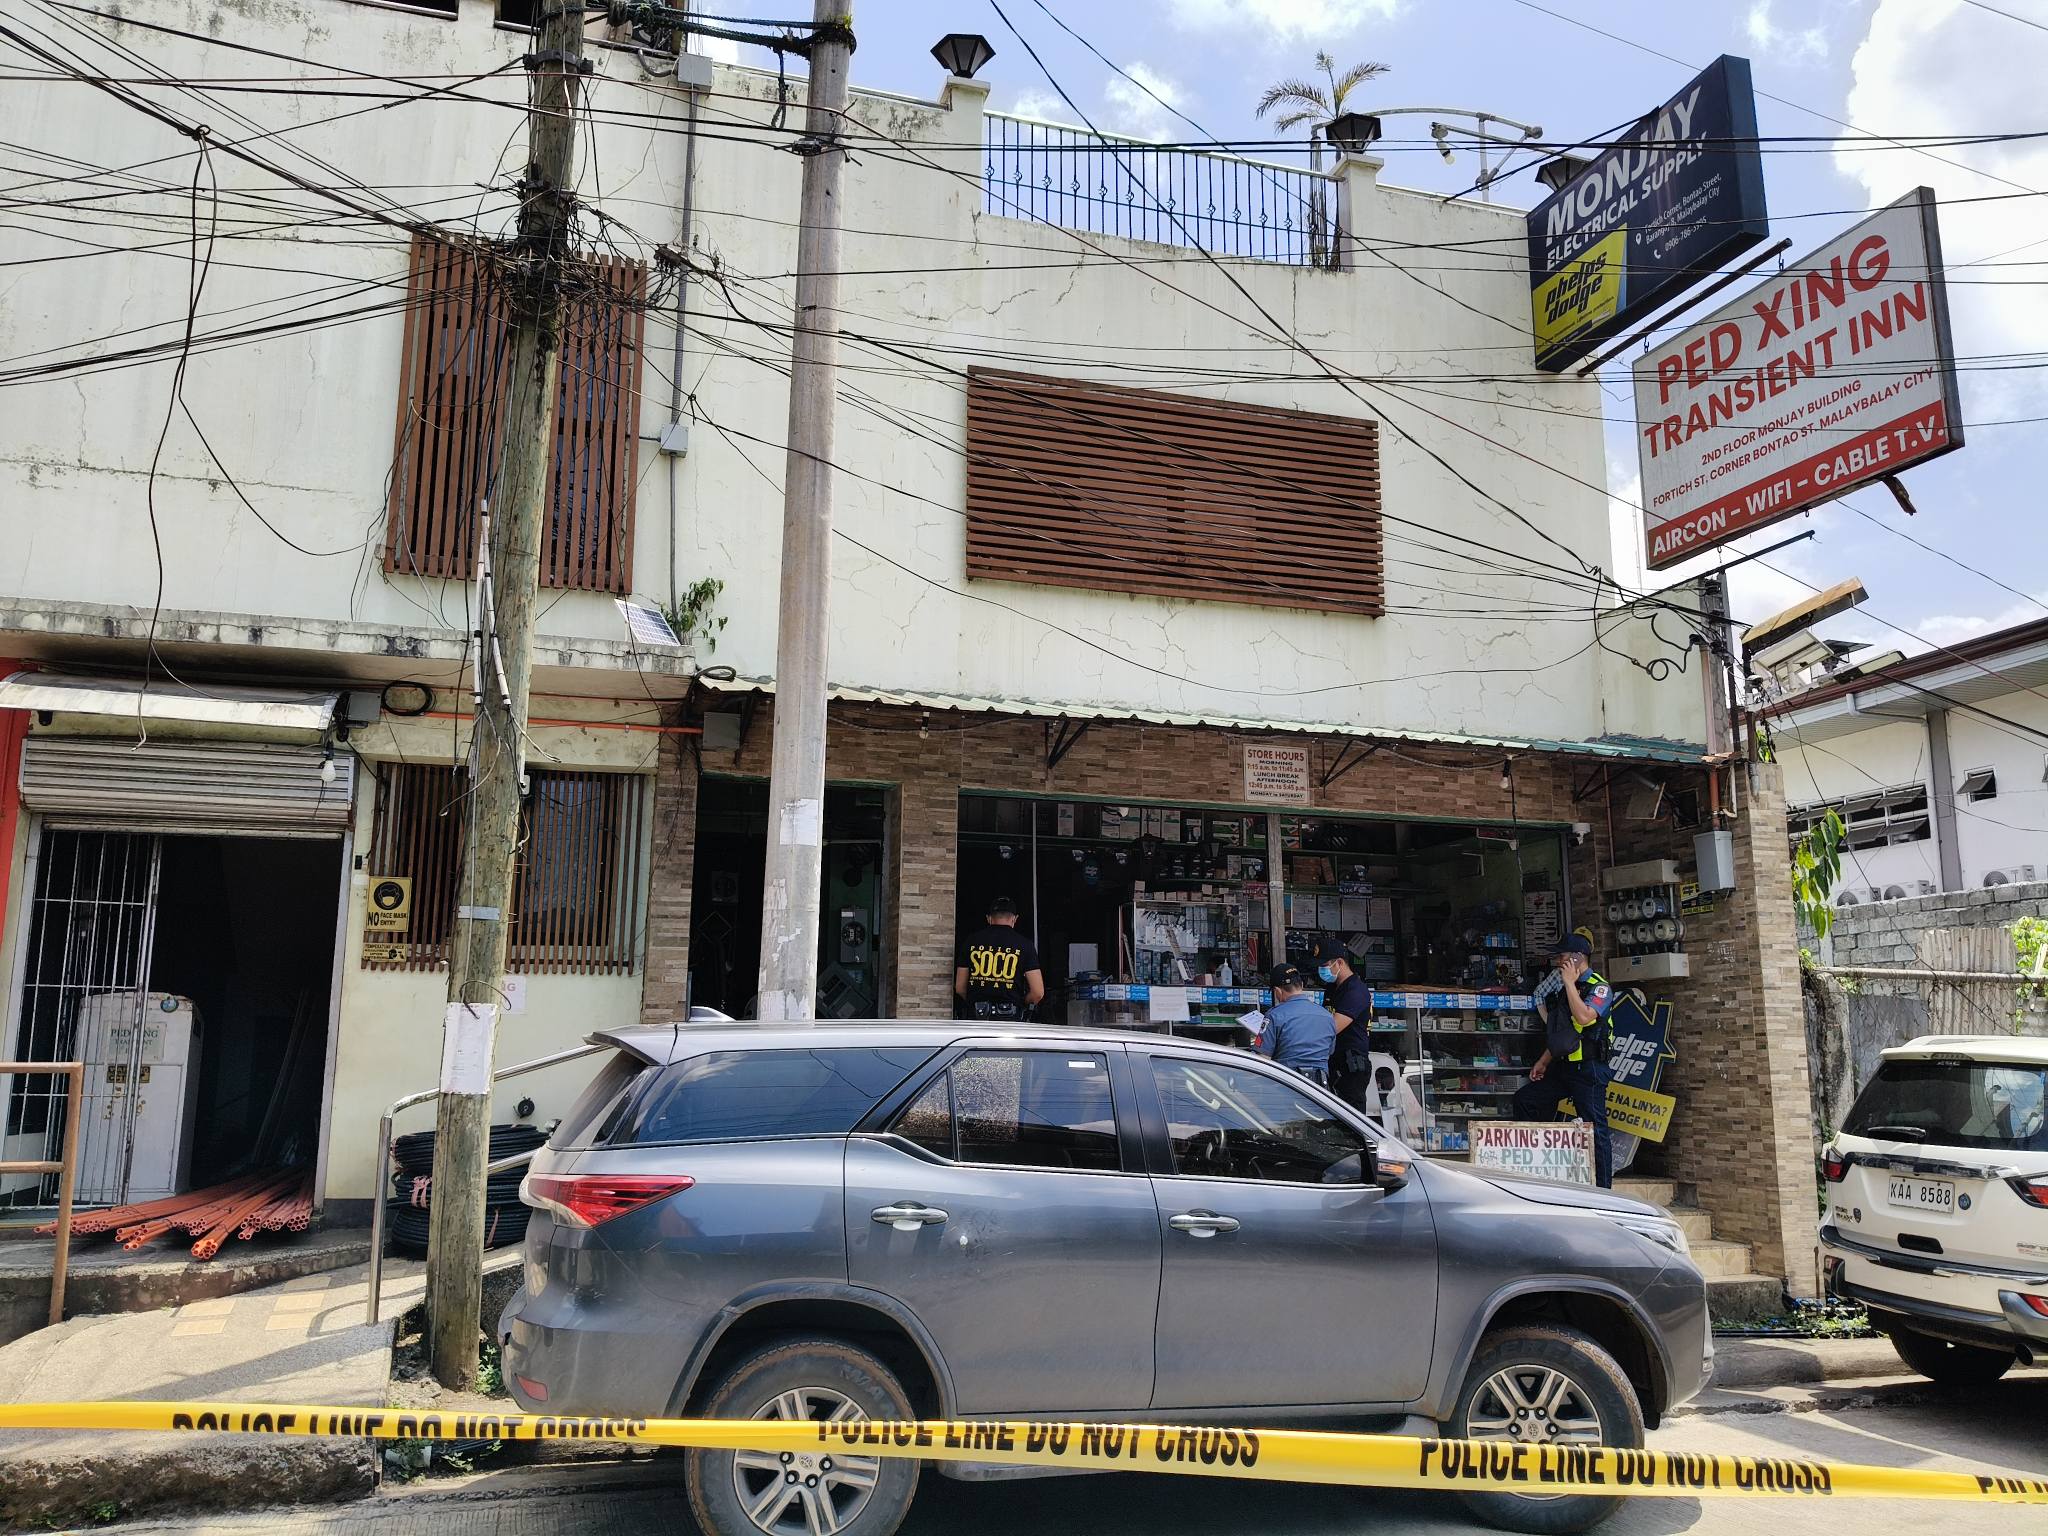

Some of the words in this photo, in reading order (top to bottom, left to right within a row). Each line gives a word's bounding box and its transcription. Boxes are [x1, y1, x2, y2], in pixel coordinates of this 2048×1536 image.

[1546, 86, 1702, 247] MONJAY
[1547, 189, 1638, 271] ELECTRICAL
[1641, 131, 1707, 200] SUPPLY
[1708, 185, 1720, 199] City
[1544, 251, 1608, 313] phelps
[1546, 274, 1603, 326] dodge
[1657, 322, 1742, 405] PED
[1752, 234, 1890, 351] XING
[1643, 327, 1838, 459] TRANSIENT
[1848, 281, 1927, 356] INN
[1652, 482, 1693, 508] FORTICH
[1709, 453, 1751, 480] CORNER
[1753, 431, 1799, 461] BONTAO
[1819, 384, 1901, 428] MALAYBALAY
[1903, 366, 1934, 389] CITY
[1701, 447, 1722, 466] 2ND
[1723, 432, 1756, 457] FLOOR
[1757, 406, 1805, 438] MONJAY
[1807, 379, 1862, 414] BUILDING
[1652, 507, 1727, 557] AIRCON
[1745, 478, 1793, 515] WIFI
[1813, 435, 1891, 487] CABLE
[1894, 415, 1945, 451] T.V.
[1247, 749, 1273, 760] STORE
[1275, 751, 1305, 761] HOURS
[1248, 781, 1263, 789] 12:45
[367, 911, 379, 926] NO
[970, 945, 1021, 956] POLICE
[970, 950, 1019, 979] SOCO
[1616, 1093, 1630, 1106] NA
[1631, 1095, 1668, 1117] LINYA?
[1476, 1128, 1539, 1148] PARKING
[1543, 1129, 1589, 1150] SPACE
[1500, 1148, 1534, 1165] PED
[1541, 1149, 1585, 1166] XING
[1890, 1182, 1911, 1200] KAA
[1920, 1186, 1951, 1205] 8588
[818, 1421, 934, 1447] POLICE
[944, 1421, 1015, 1451] LINE
[1025, 1422, 1071, 1455] DO
[1080, 1423, 1141, 1459] NOT
[1155, 1424, 1260, 1468] CROSS
[1419, 1438, 1529, 1481] POLICE
[1539, 1443, 1606, 1484] LINE
[1615, 1447, 1656, 1487] DO
